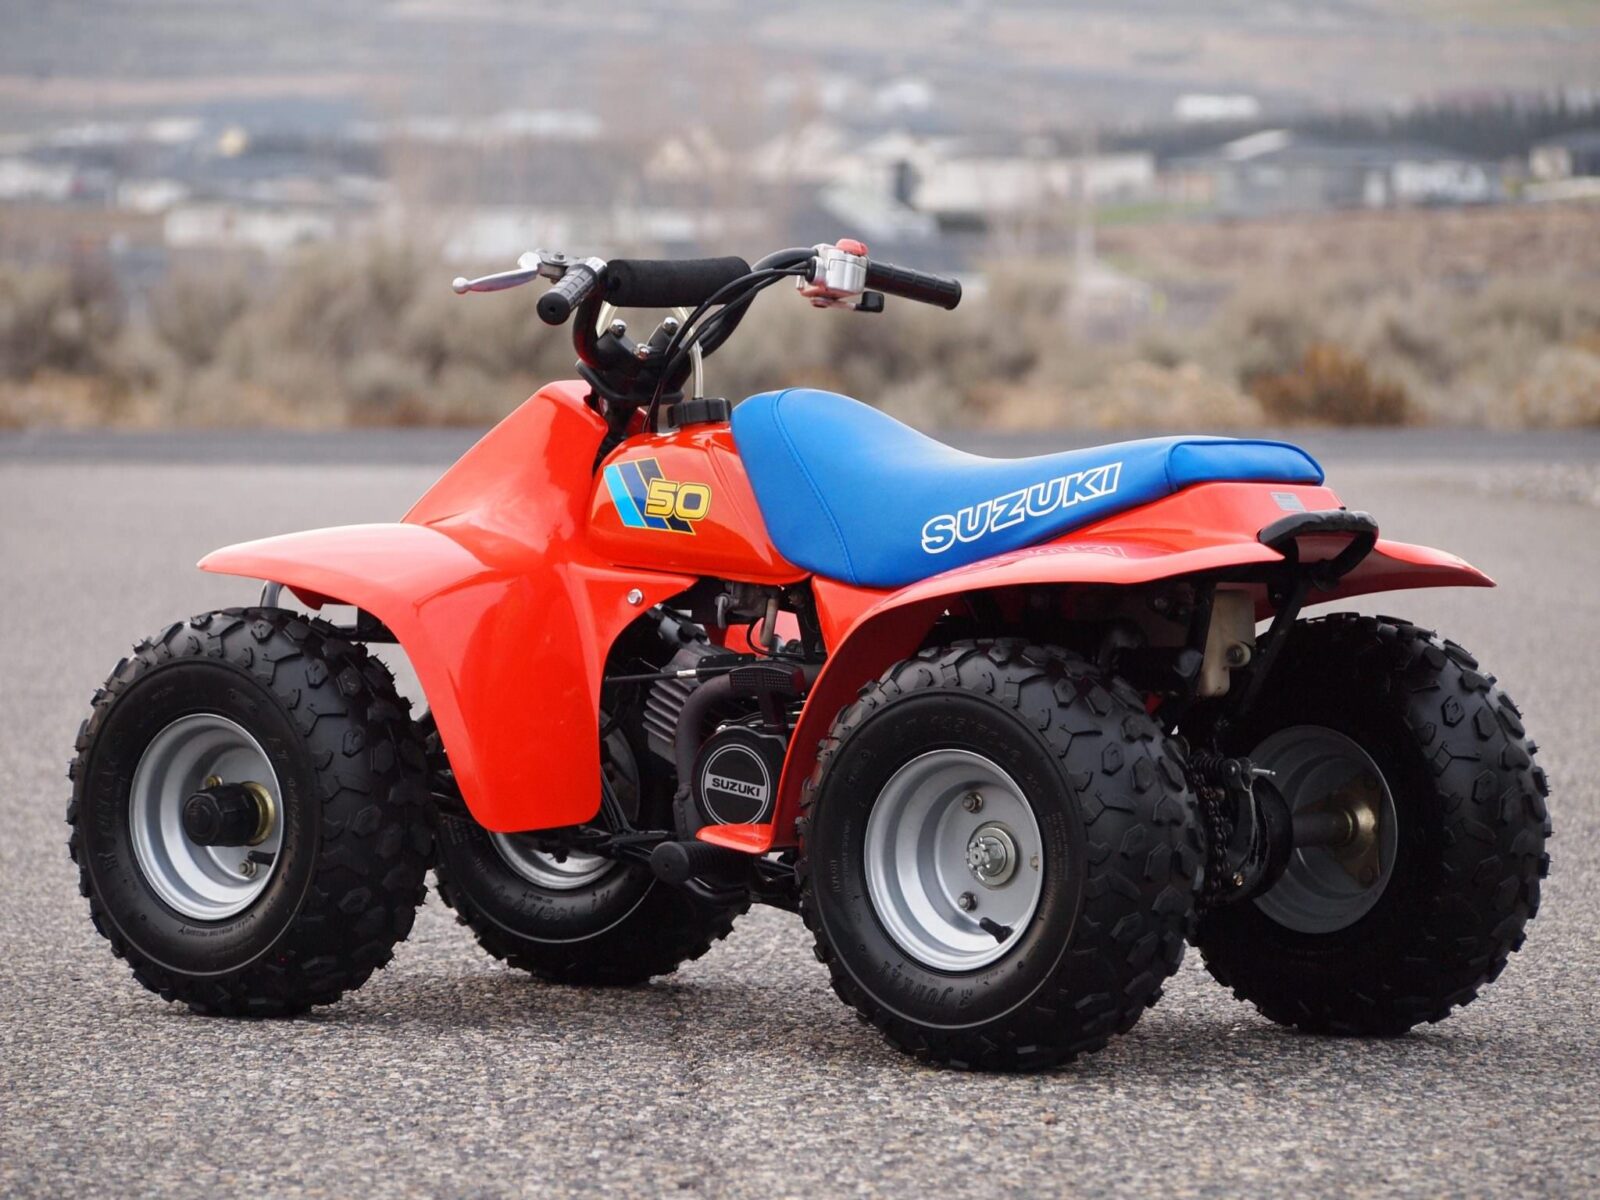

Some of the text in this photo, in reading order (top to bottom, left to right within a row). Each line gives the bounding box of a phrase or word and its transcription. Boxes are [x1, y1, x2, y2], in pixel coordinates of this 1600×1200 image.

[645, 478, 711, 520] 50
[921, 462, 1122, 554] SUZUKI
[711, 777, 760, 797] SUZUKI
